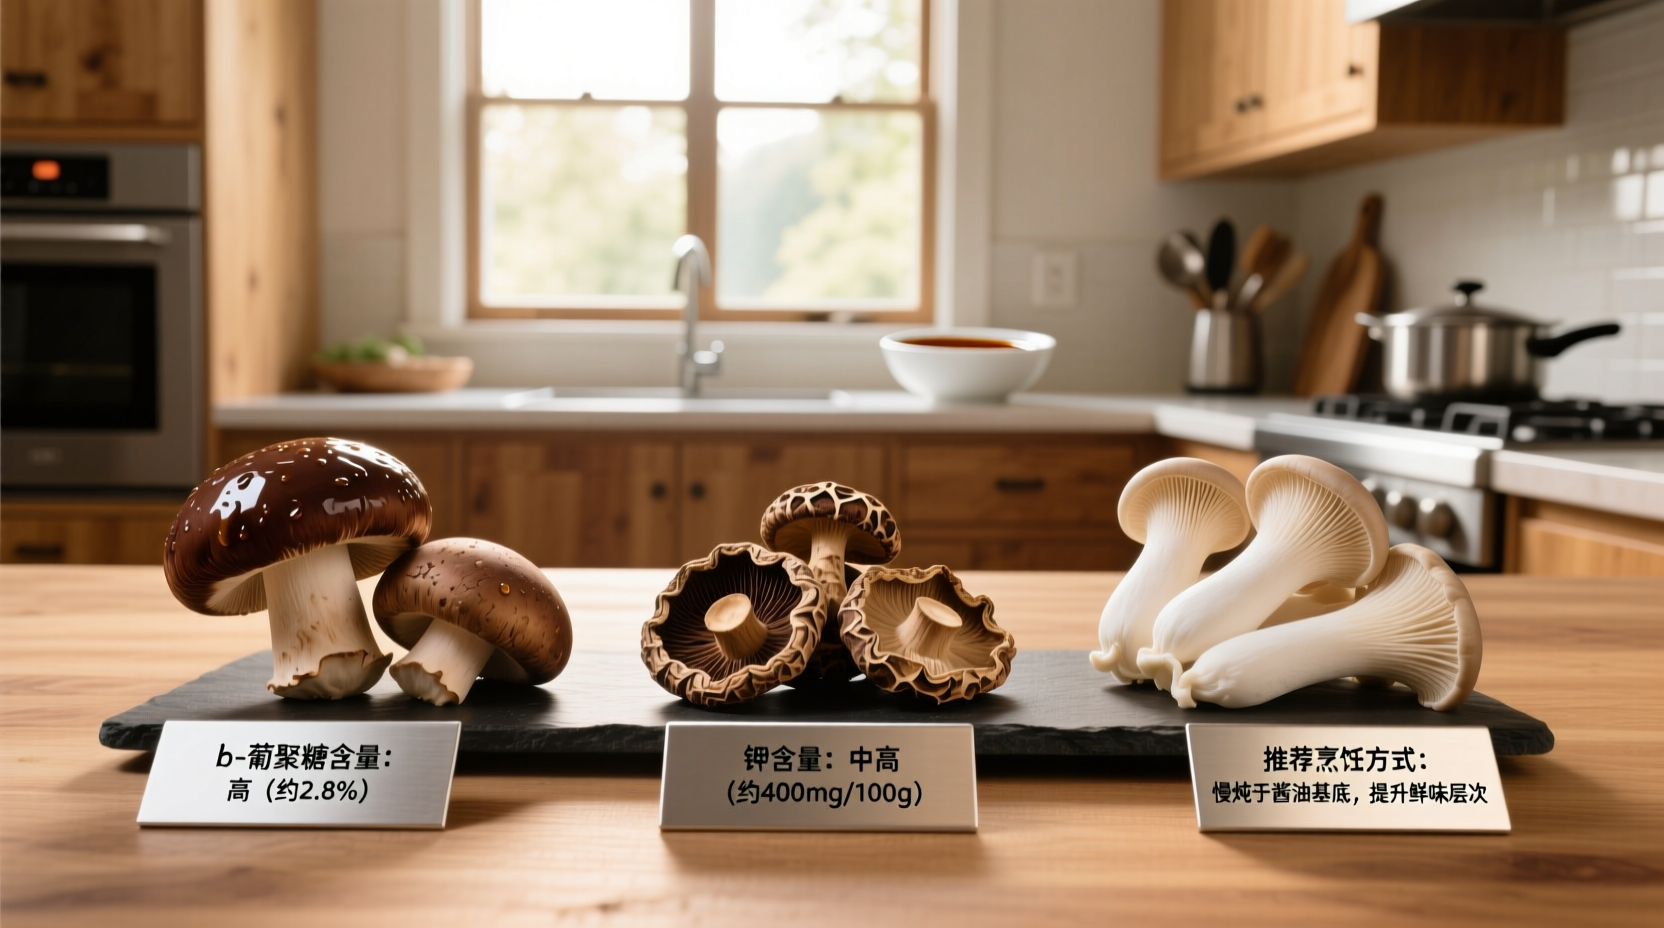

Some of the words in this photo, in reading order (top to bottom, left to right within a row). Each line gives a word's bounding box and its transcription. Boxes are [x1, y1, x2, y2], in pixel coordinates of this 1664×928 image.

[1263, 746, 1427, 772] 推荐烹饪方式：
[726, 779, 923, 809] (约400mg/100g)
